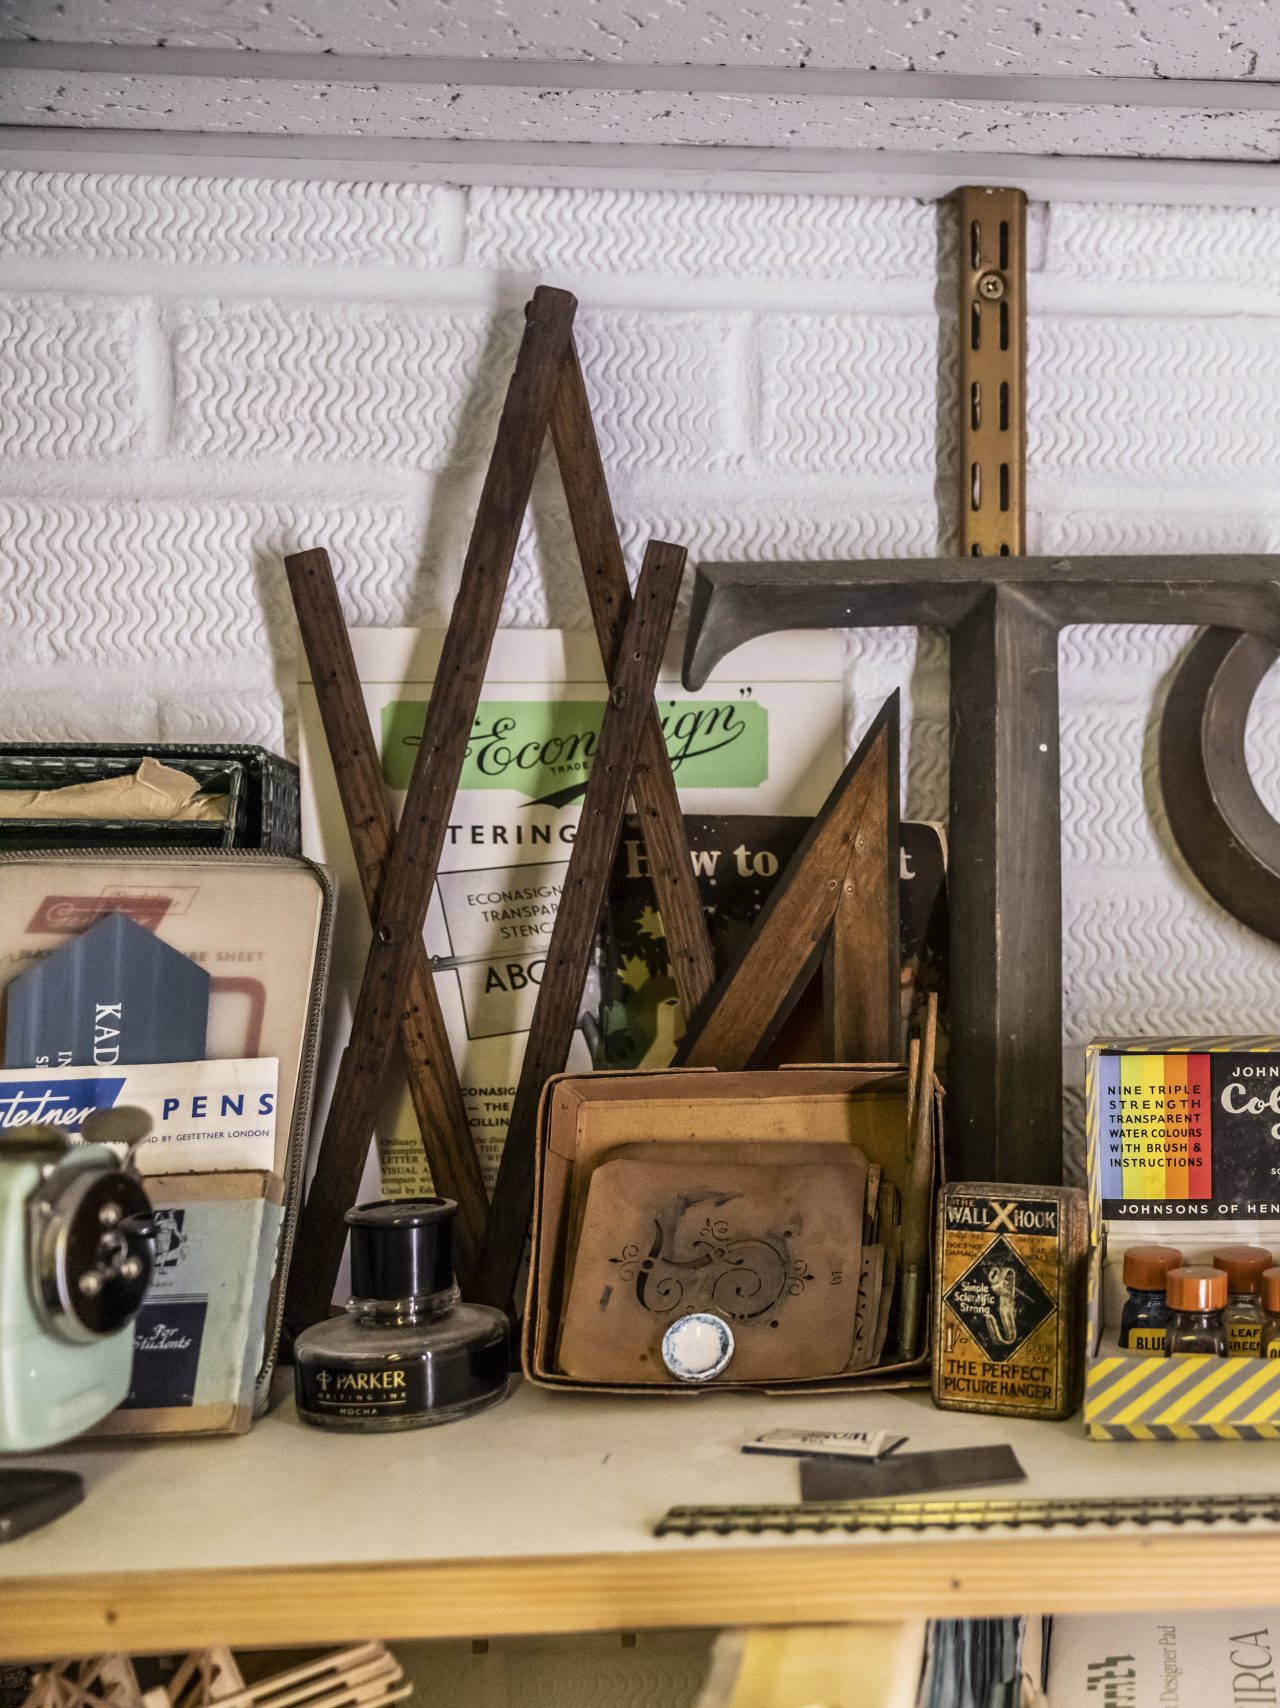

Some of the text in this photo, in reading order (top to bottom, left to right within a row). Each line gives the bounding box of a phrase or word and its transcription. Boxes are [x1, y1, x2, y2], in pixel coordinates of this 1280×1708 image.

[550, 760, 588, 775] TRADE
[625, 840, 779, 878] Hw to
[216, 951, 263, 962] SHEET
[1108, 1085, 1201, 1096] NINE TRIPLE
[162, 1093, 274, 1121] PENS
[484, 1102, 510, 1112] THE
[1109, 1100, 1201, 1110] STRENGTH
[1109, 1114, 1201, 1124] TRANSPARENT
[162, 1134, 174, 1142] BY
[176, 1131, 225, 1141] GESTETNER
[227, 1130, 270, 1139] LONDON
[1109, 1129, 1202, 1138] WATER COLOURS
[1110, 1143, 1201, 1153] WITH BRUSH &
[1110, 1158, 1203, 1168] INSTRUCTIONS
[1119, 1204, 1209, 1214] JOHNSONS
[1218, 1204, 1239, 1213] OF
[946, 1201, 1056, 1232] WALL X HOOK
[961, 1281, 989, 1293] Simple
[954, 1291, 995, 1306] Scientific
[960, 1302, 990, 1317] Strong
[151, 1324, 179, 1338] For
[1231, 1328, 1259, 1338] LEAF
[948, 1359, 1049, 1382] THE PERFECT
[337, 1370, 407, 1389] PARKER
[944, 1376, 1052, 1400] PICTURE HANGER
[383, 1391, 407, 1400] INK
[339, 1408, 378, 1416] MOCHA
[1156, 1625, 1183, 1702] Designer Pad
